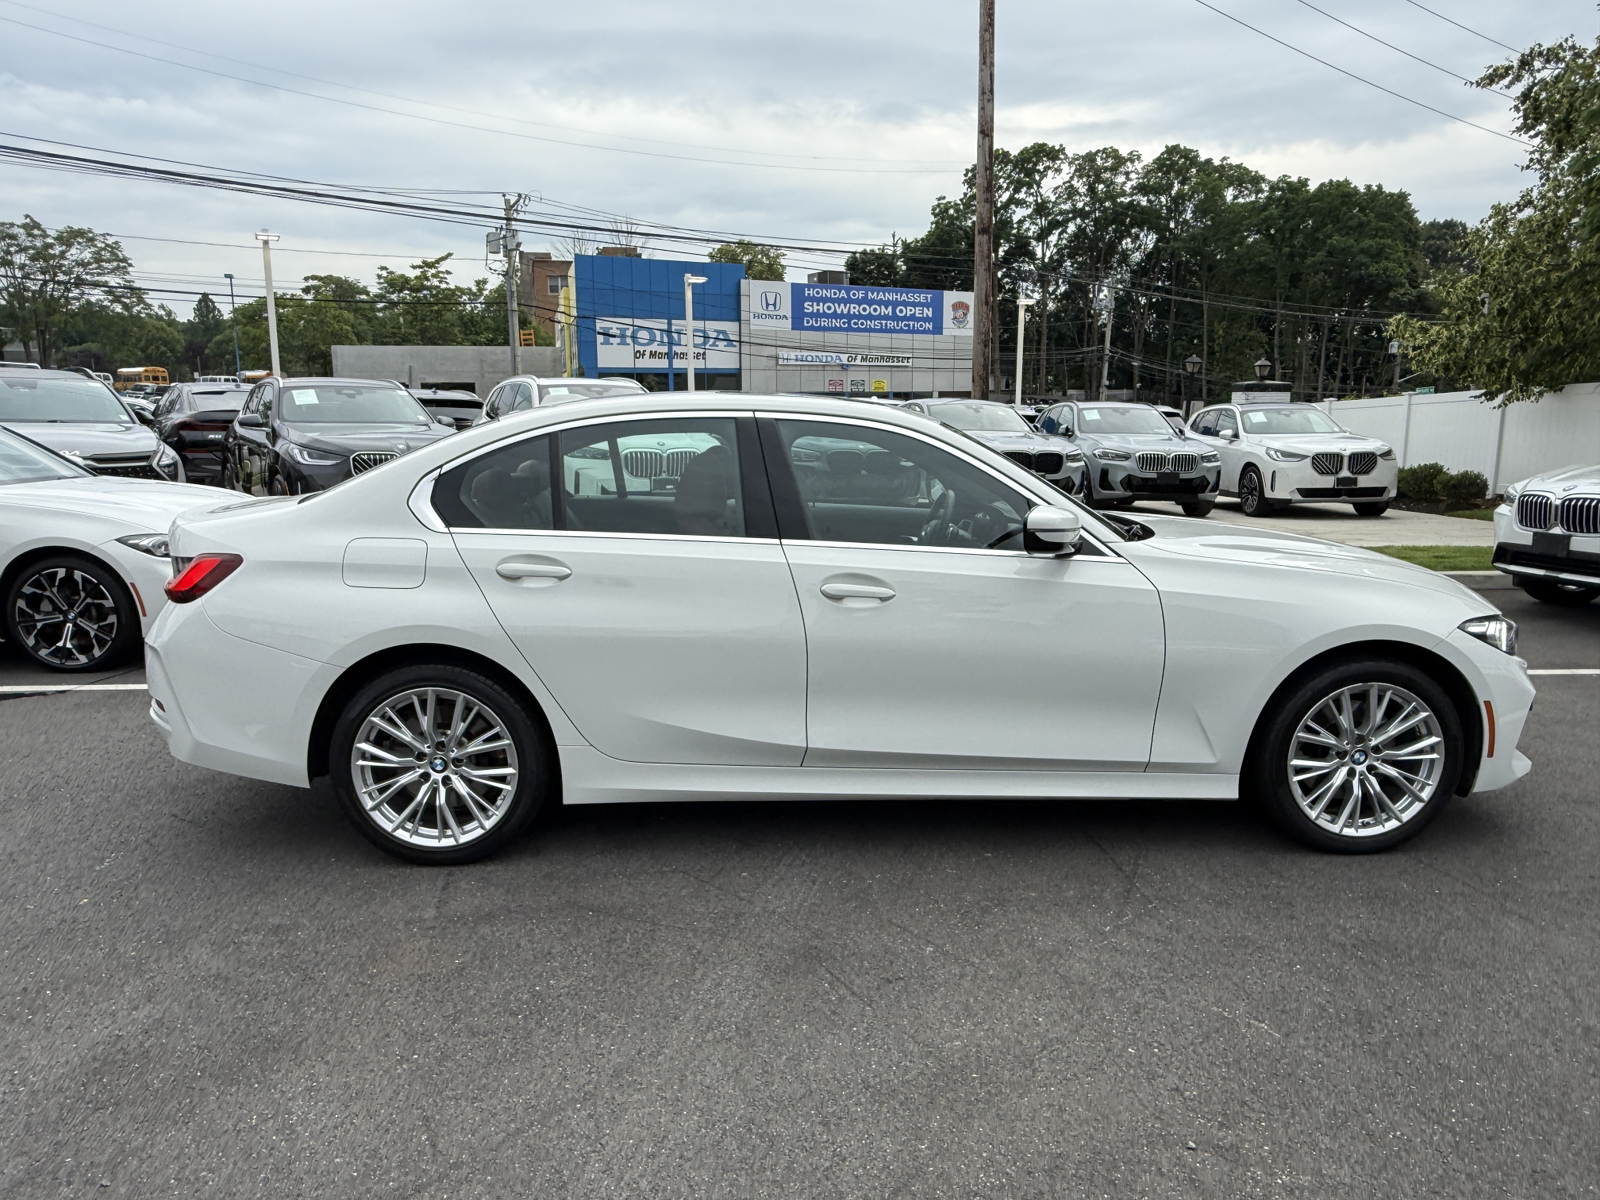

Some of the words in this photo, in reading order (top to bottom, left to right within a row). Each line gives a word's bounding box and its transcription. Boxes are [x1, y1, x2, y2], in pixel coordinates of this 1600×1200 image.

[804, 287, 847, 299] HONDA
[849, 290, 865, 301] OF
[867, 291, 933, 303] MANHASSET
[752, 313, 789, 321] HONDA
[803, 302, 892, 316] SHOWROOM
[895, 305, 933, 318] OPEN
[803, 317, 848, 328] DURING
[851, 319, 933, 331] CONSTRUCTION
[599, 326, 738, 348] HONDA
[634, 349, 647, 360] Of
[794, 354, 843, 363] HONDA
[846, 355, 858, 363] Of
[860, 355, 911, 364] Manhasset
